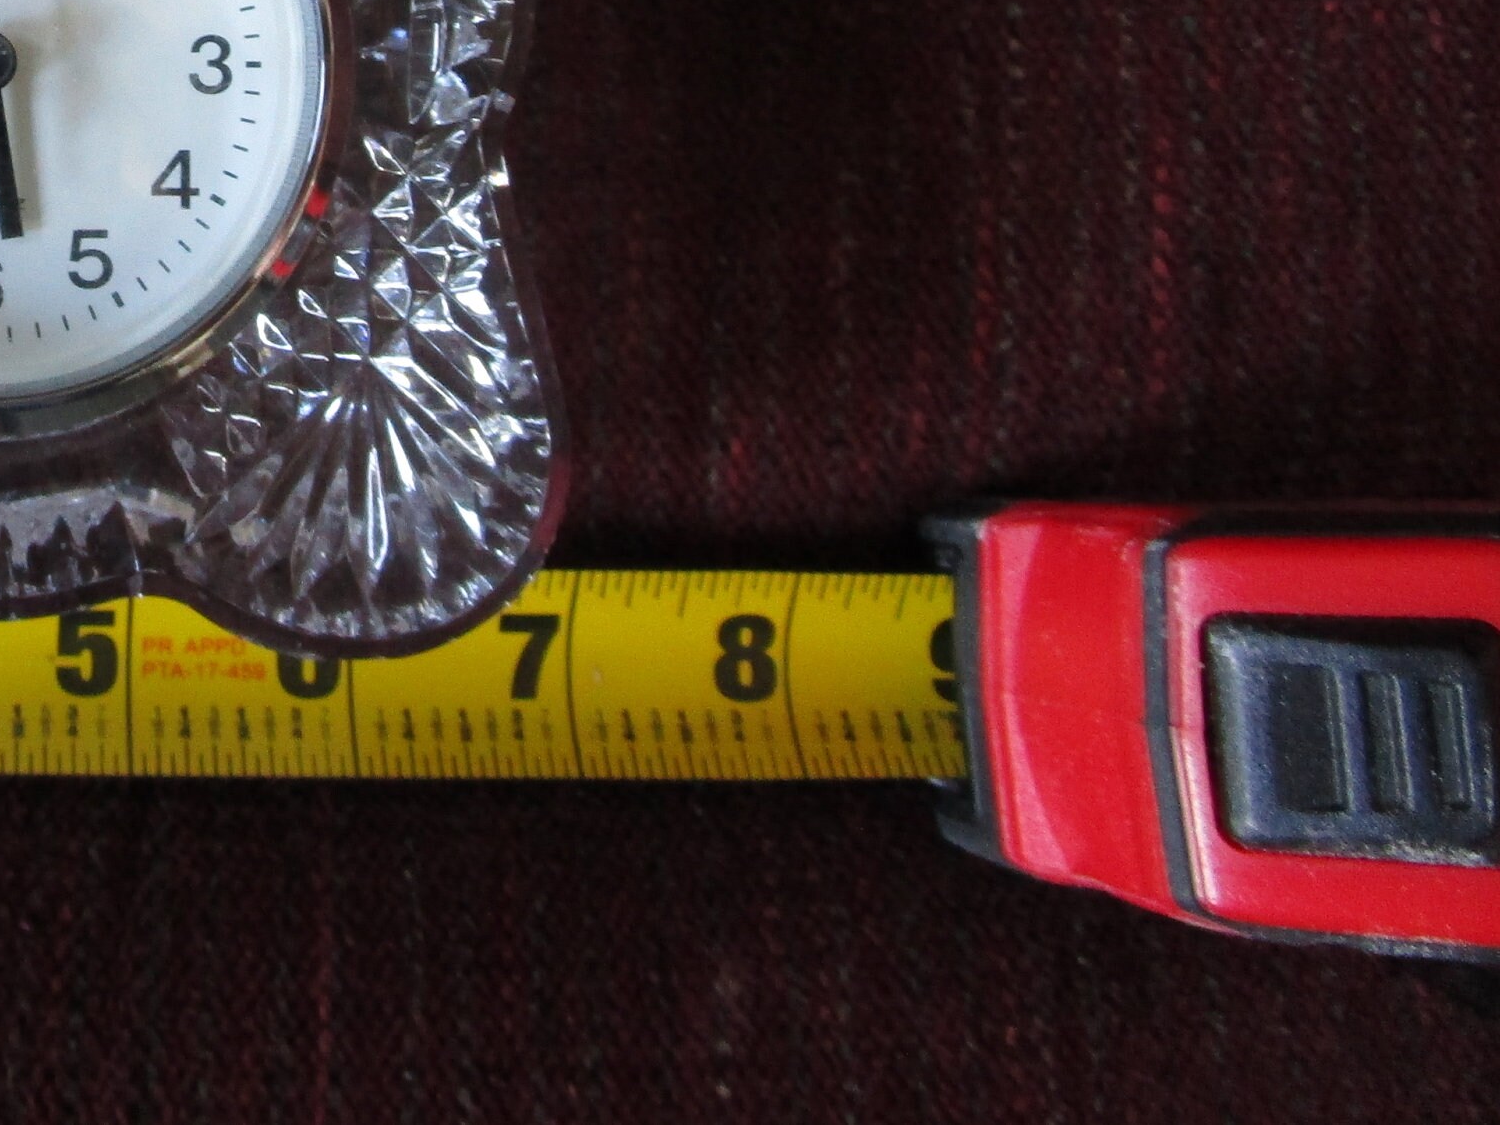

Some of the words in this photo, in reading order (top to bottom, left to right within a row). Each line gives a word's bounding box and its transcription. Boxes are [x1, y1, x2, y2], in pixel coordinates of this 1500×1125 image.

[188, 34, 233, 95] 3
[151, 149, 200, 210] 4
[67, 229, 114, 290] 5
[55, 610, 119, 697] 5
[499, 613, 560, 700] 7
[713, 614, 778, 703] 8
